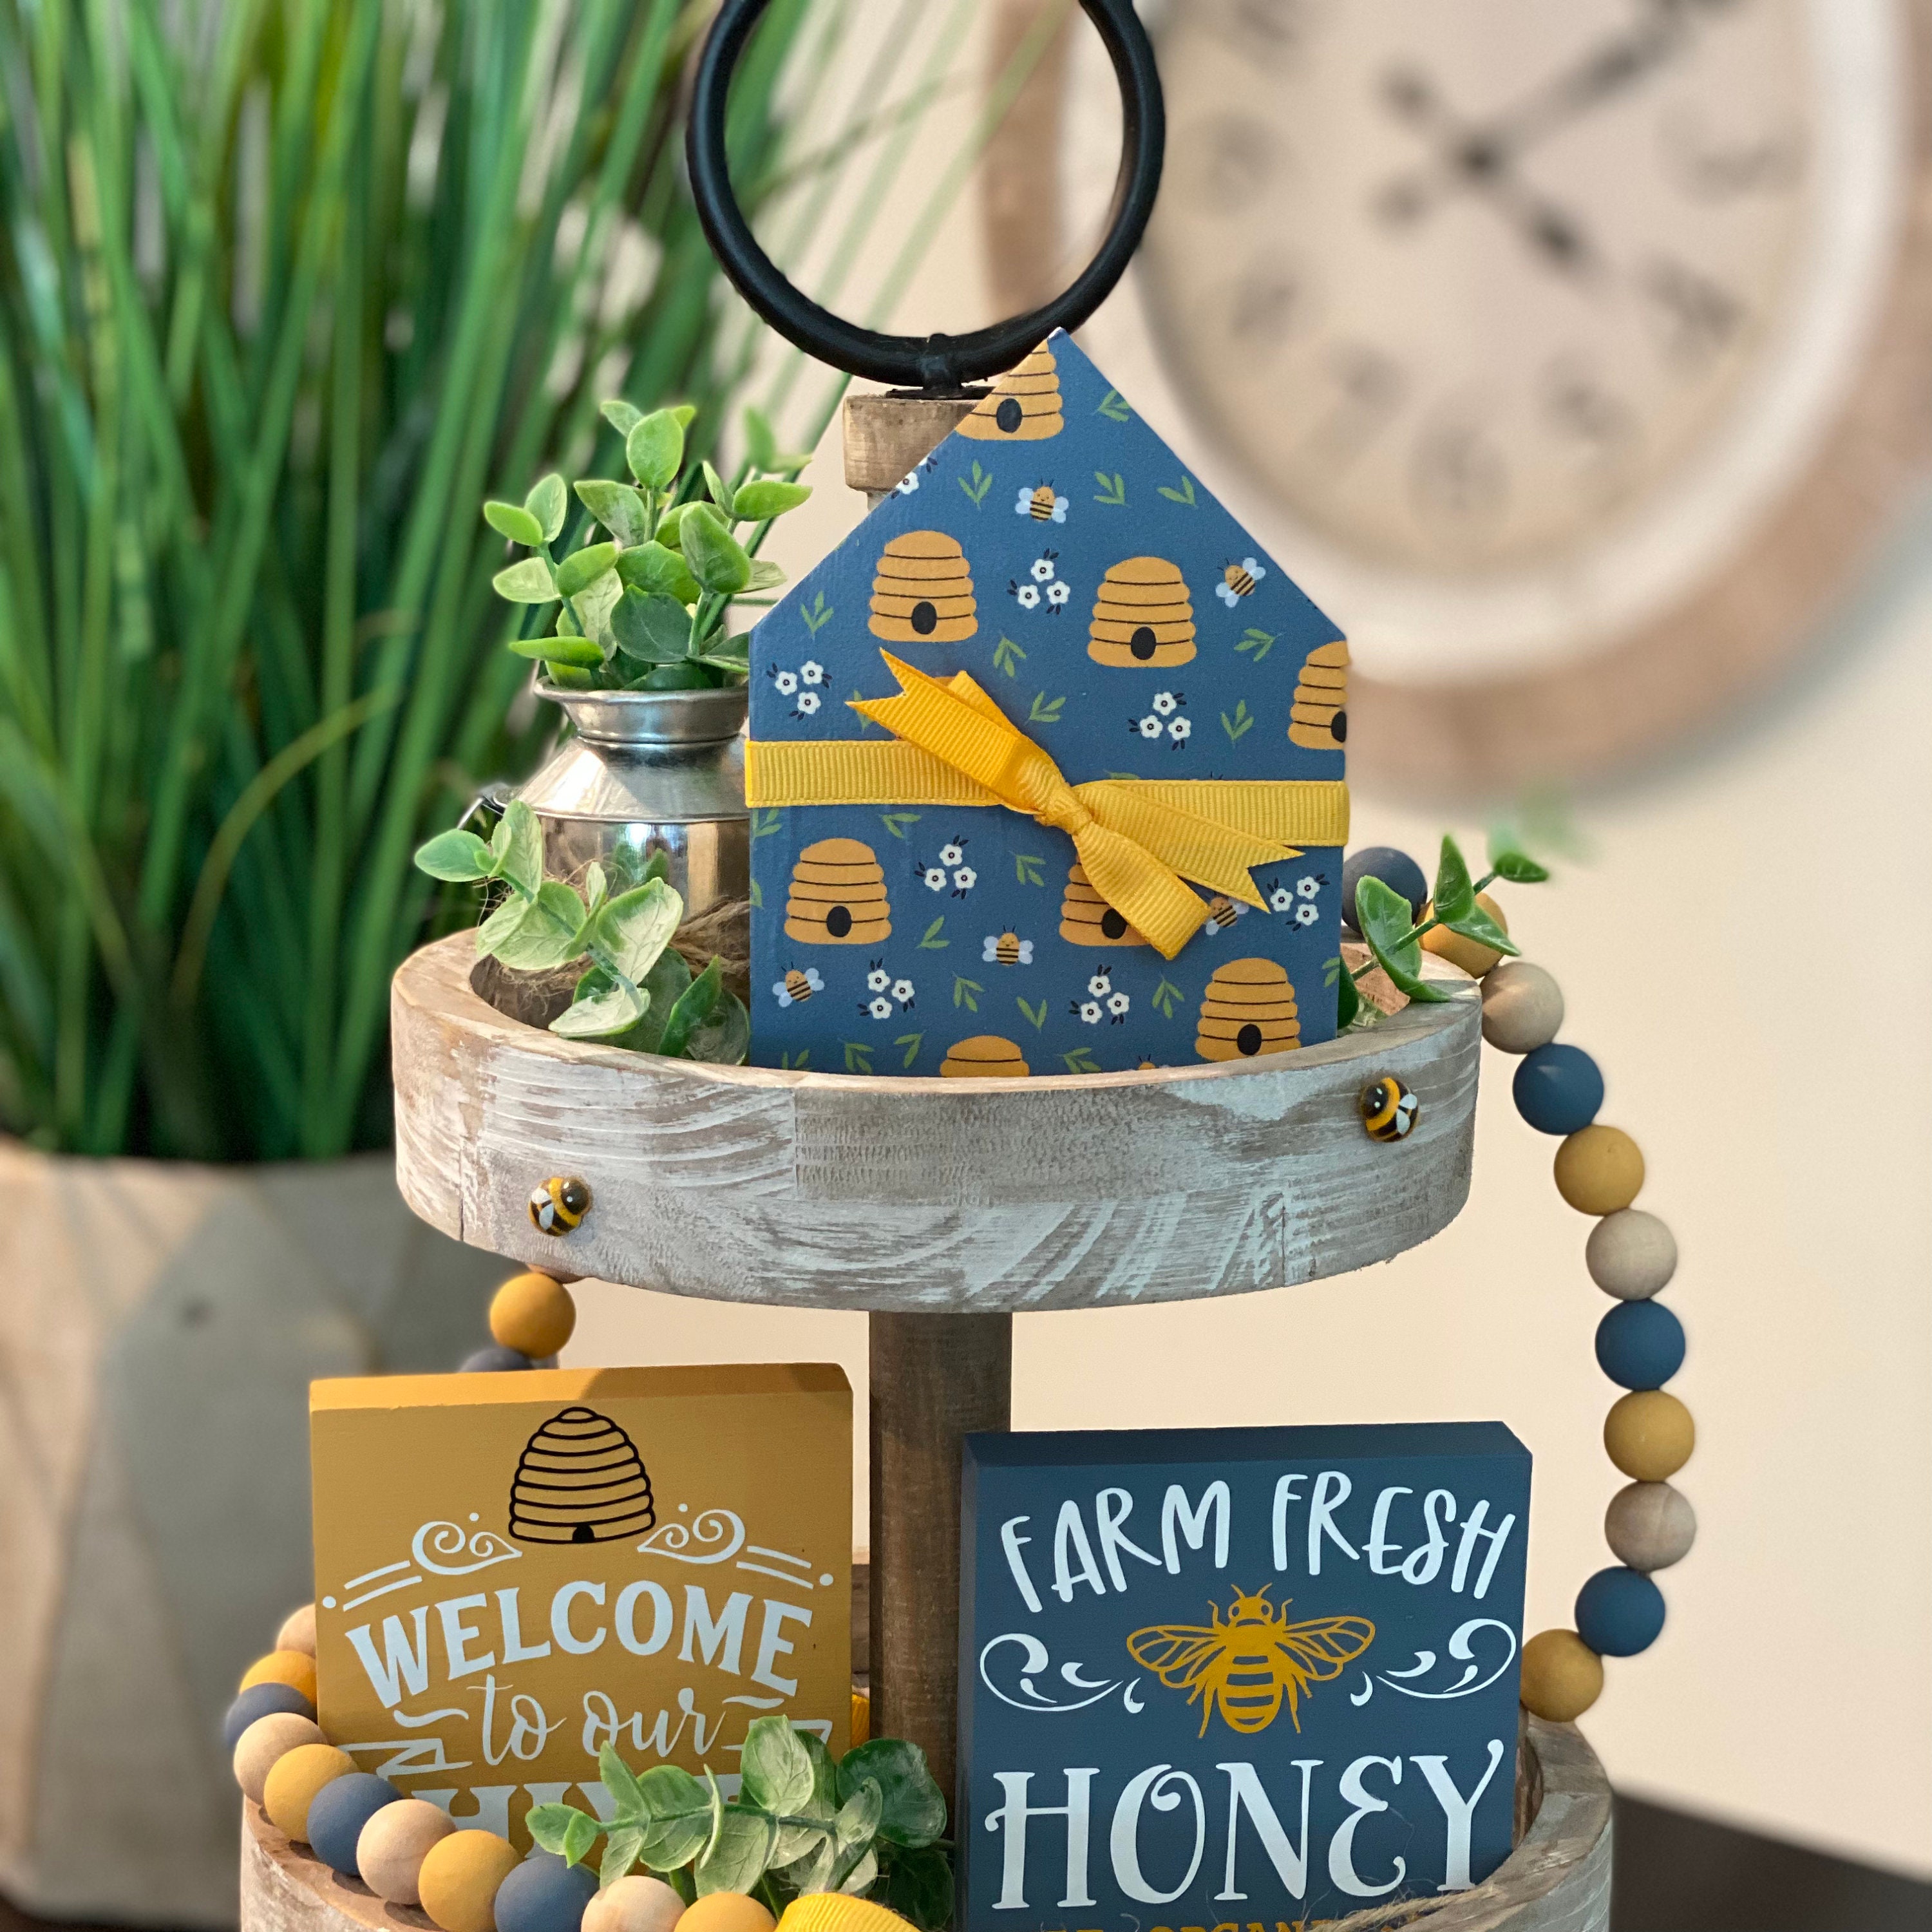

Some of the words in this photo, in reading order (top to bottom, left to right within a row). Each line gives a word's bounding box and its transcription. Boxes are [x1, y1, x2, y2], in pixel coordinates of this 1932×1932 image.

[1000, 1479, 1231, 1613] FARM
[1271, 1470, 1516, 1600] FRESH
[345, 1580, 813, 1709] WELCOME
[466, 1674, 567, 1766] to
[582, 1687, 726, 1758] our
[985, 1739, 1504, 1910] HONEY
